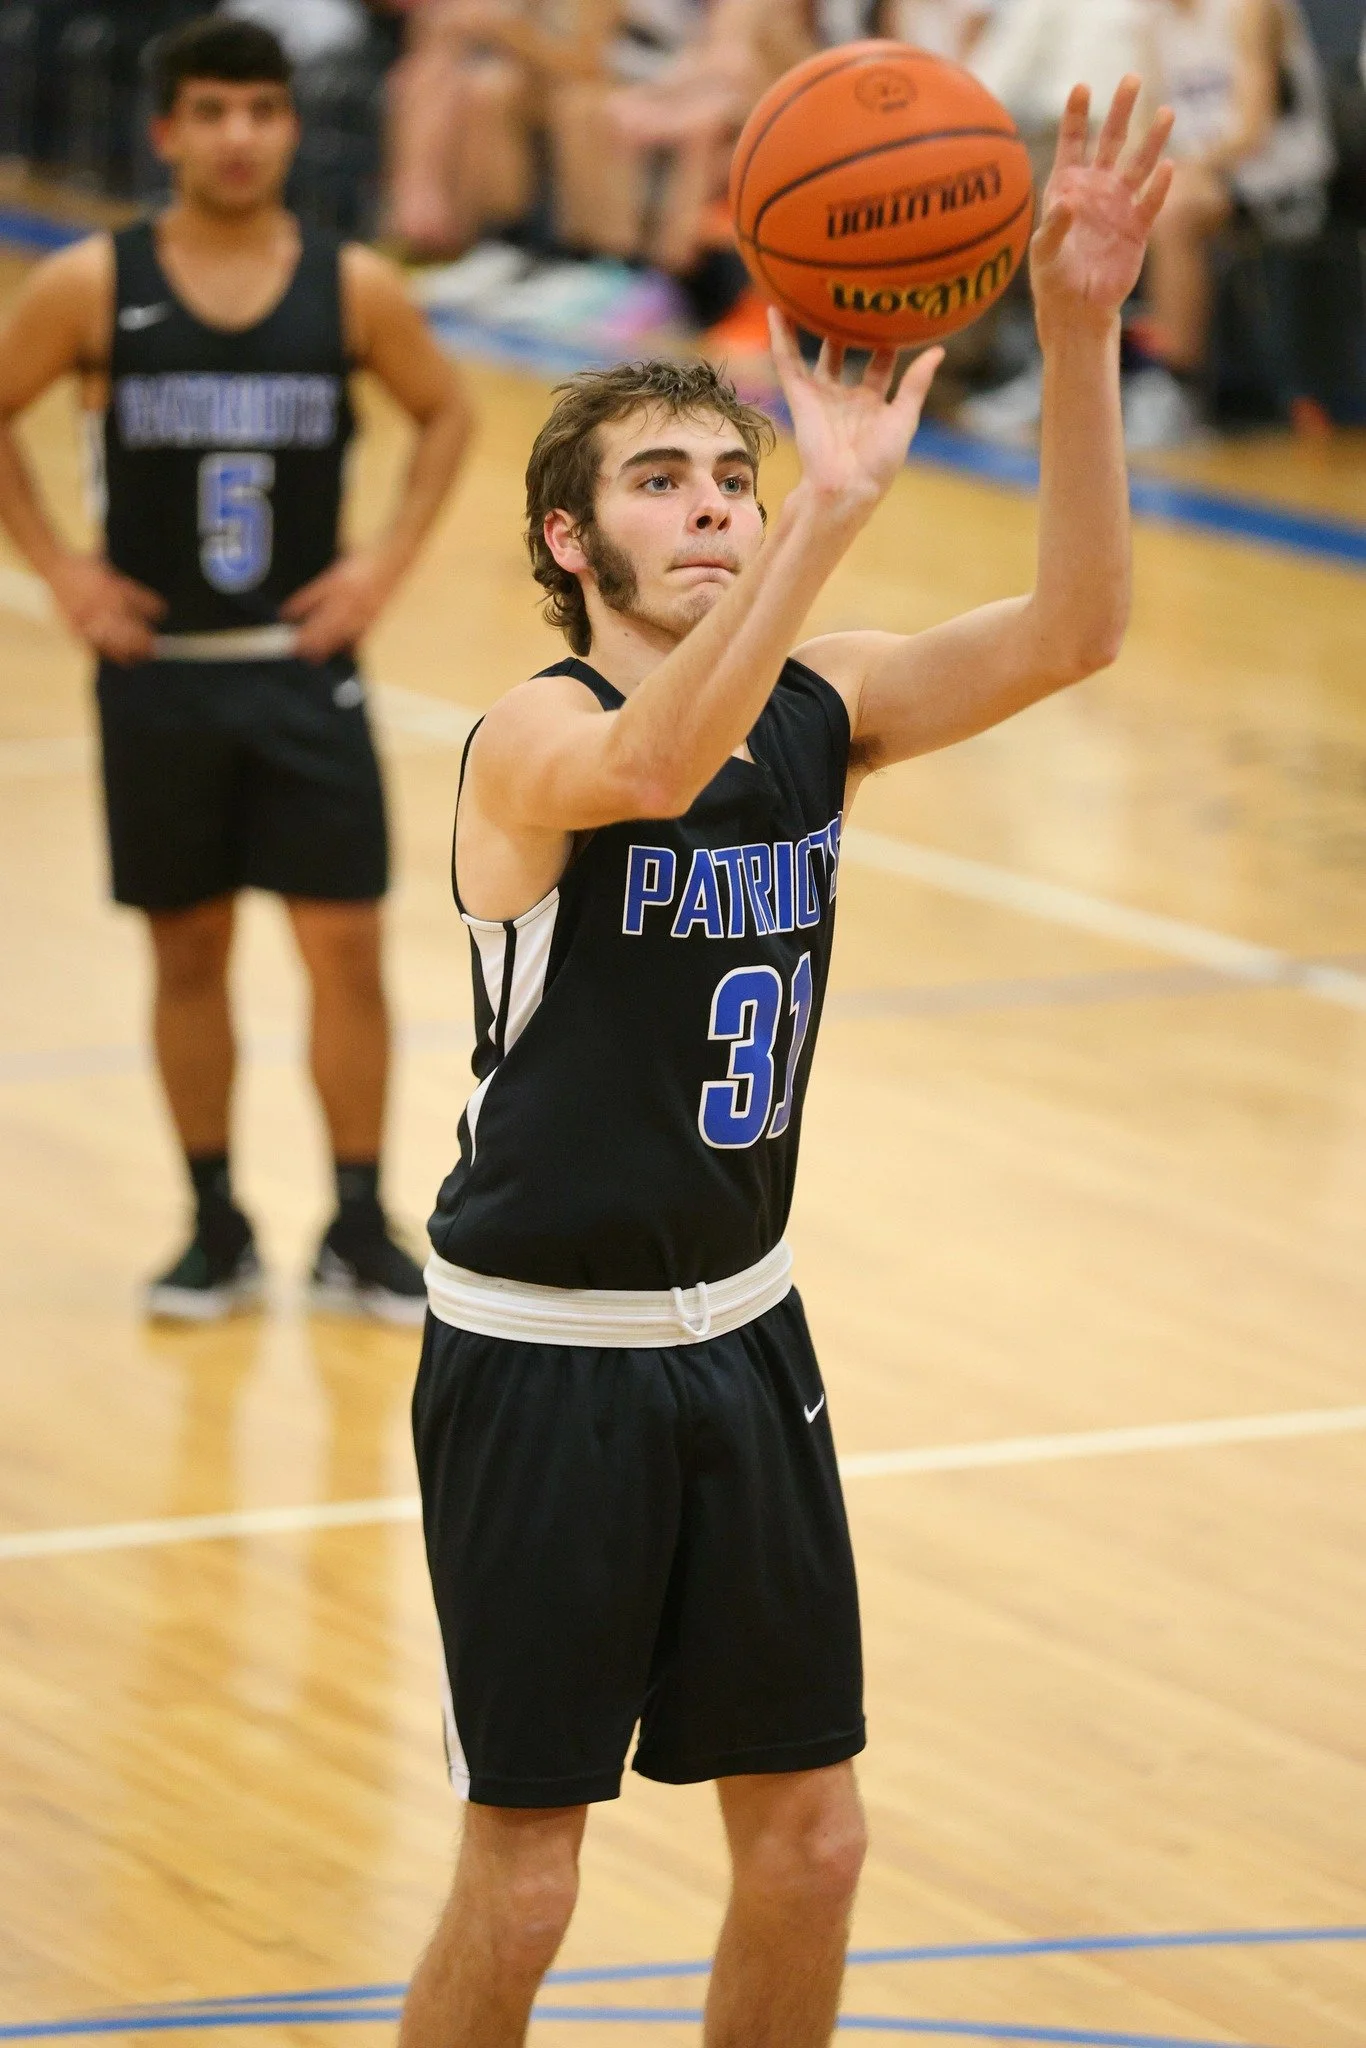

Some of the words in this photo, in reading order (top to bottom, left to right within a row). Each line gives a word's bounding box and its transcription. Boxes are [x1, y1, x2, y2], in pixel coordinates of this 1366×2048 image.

[830, 246, 1013, 318] Wilson
[197, 452, 276, 593] 5
[698, 951, 813, 1149] 31
